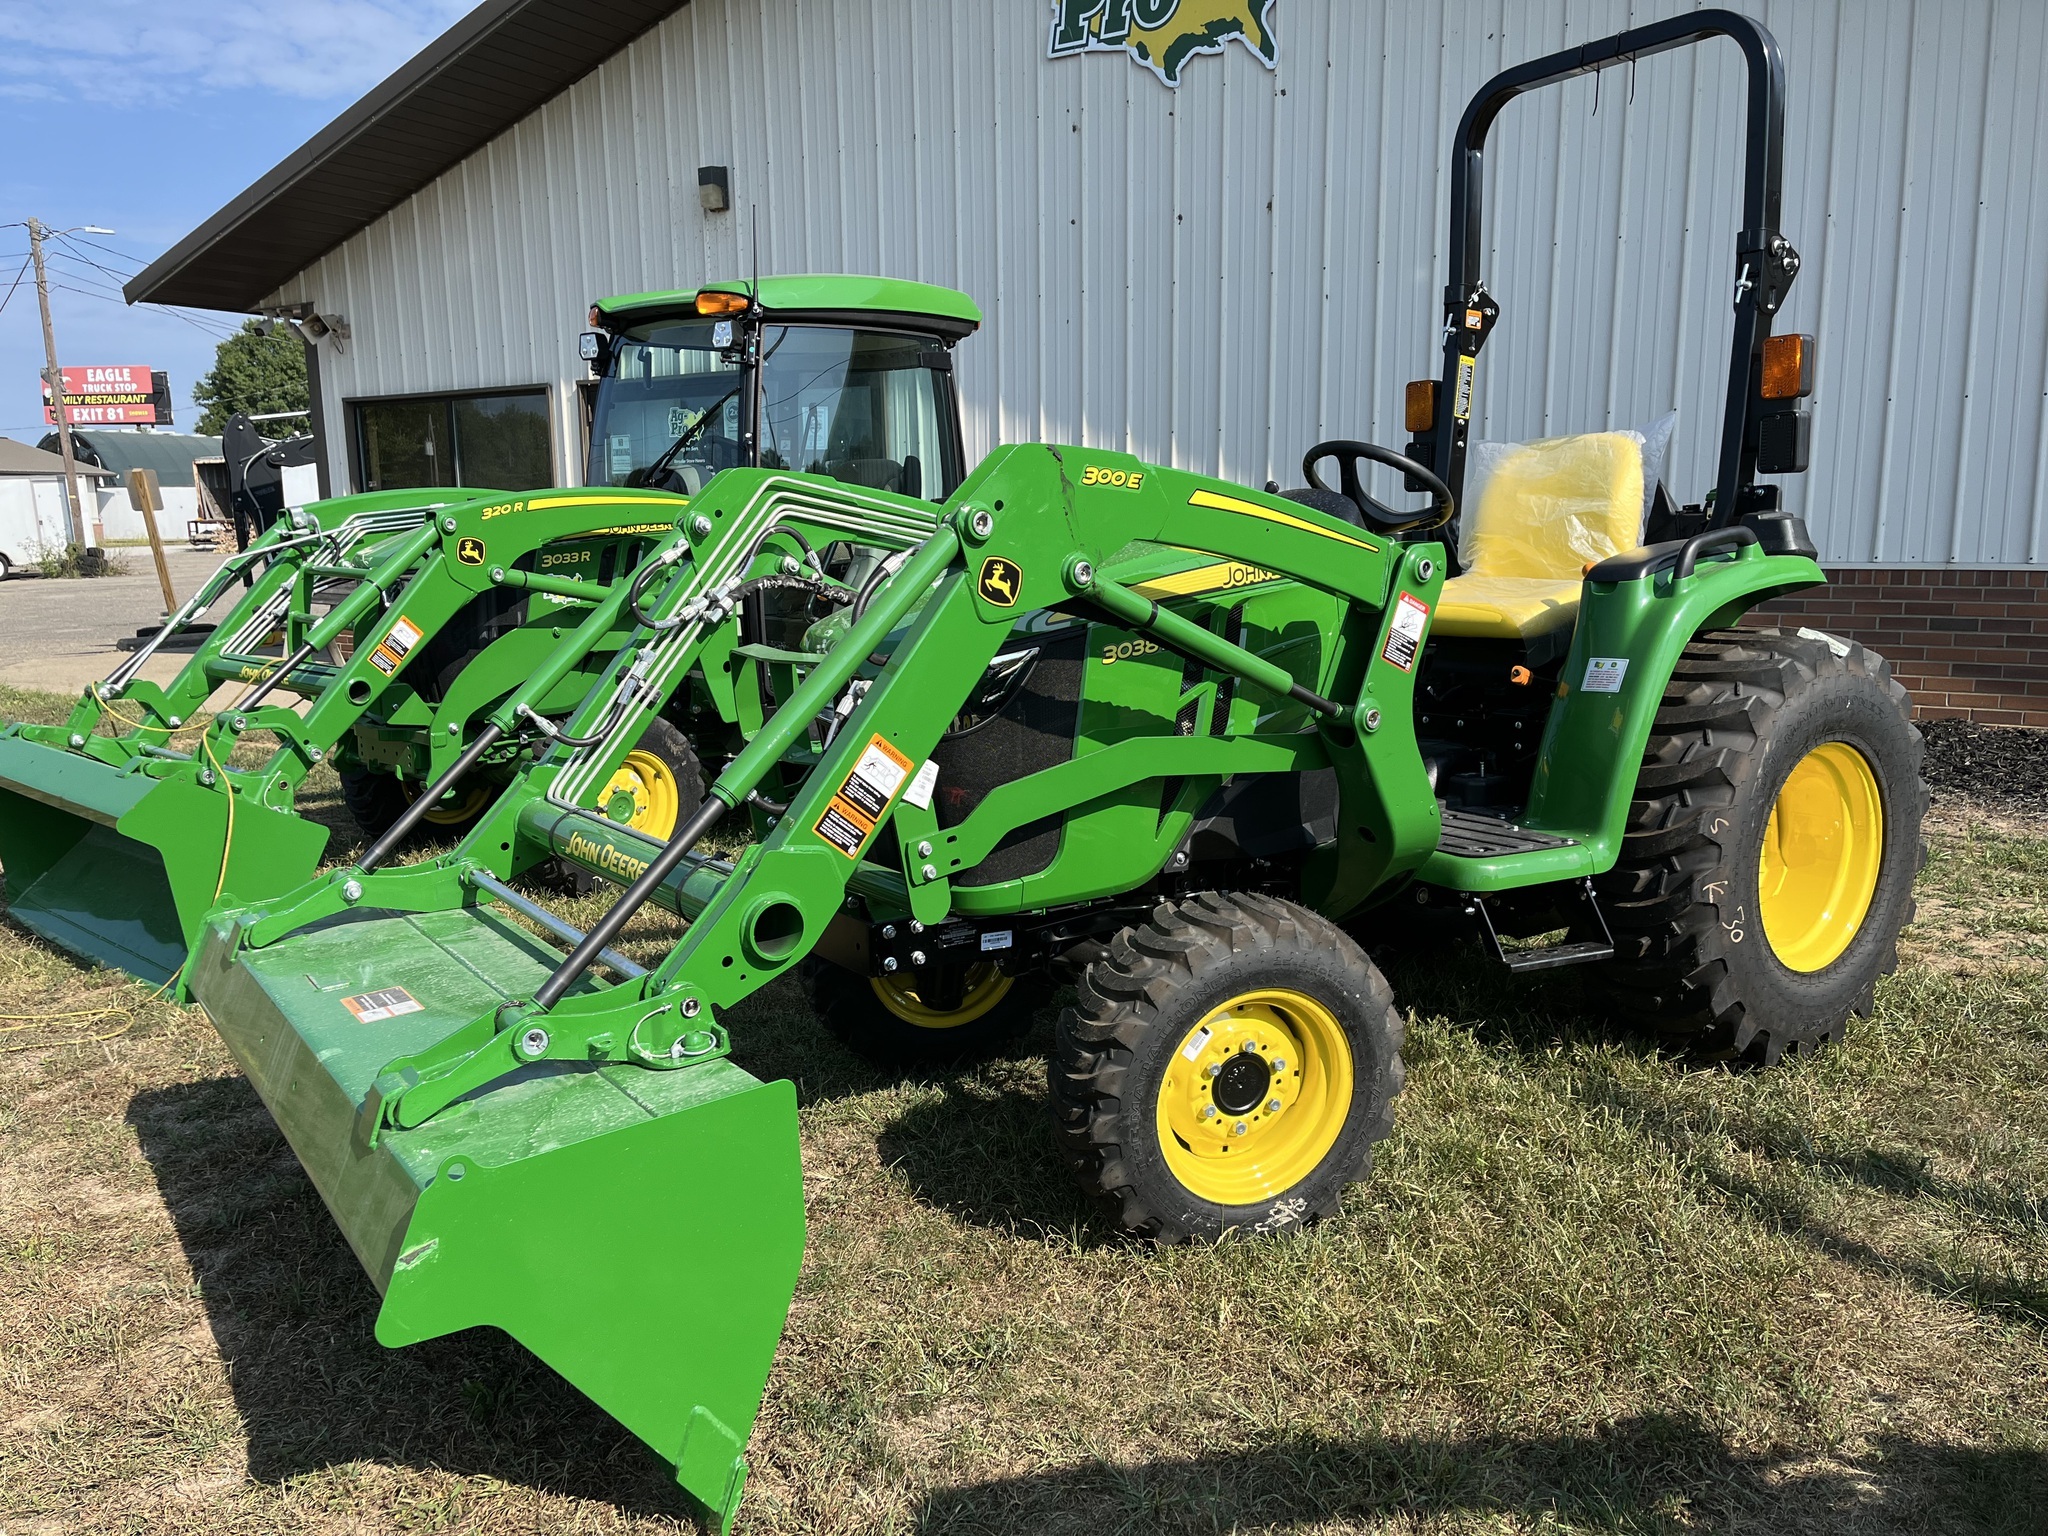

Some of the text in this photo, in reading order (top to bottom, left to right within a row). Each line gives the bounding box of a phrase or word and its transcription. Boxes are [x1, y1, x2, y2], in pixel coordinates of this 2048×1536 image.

[86, 368, 131, 382] EAGLE
[82, 383, 138, 393] TRUCK STOP
[49, 394, 147, 405] FMILY RESTAURANT
[72, 407, 103, 421] EXIT
[106, 407, 124, 420] 81
[671, 409, 688, 424] Ag-
[671, 423, 688, 435] Pro
[882, 744, 908, 769] WARNING
[841, 807, 869, 831] WARNING
[565, 831, 601, 865] JOHN
[1128, 962, 1242, 1122] MARATHONER
